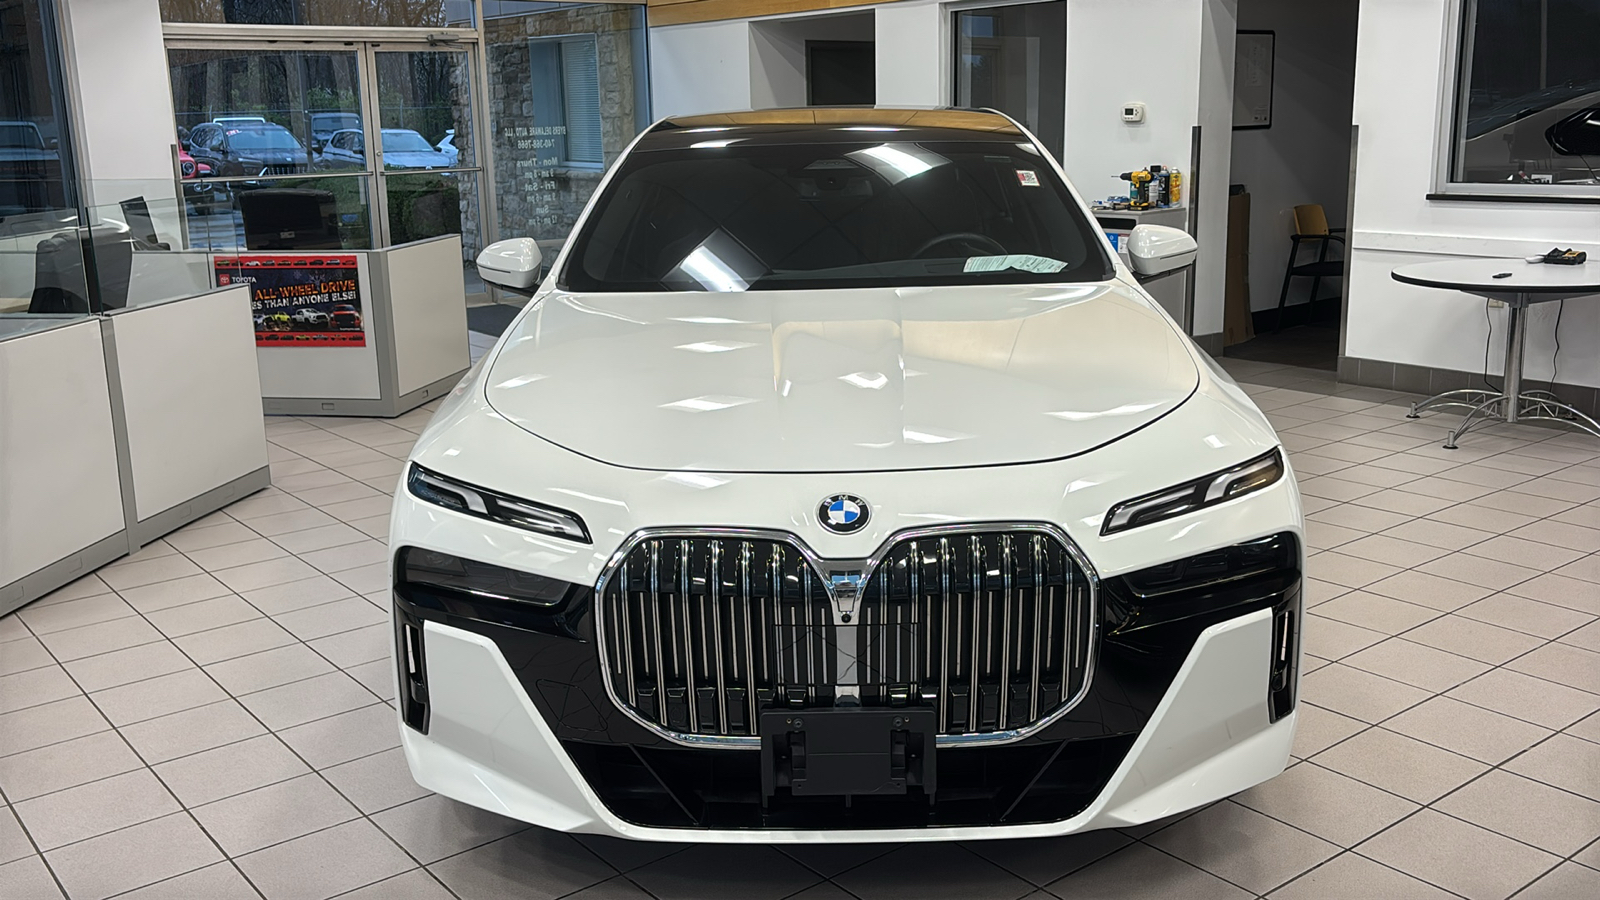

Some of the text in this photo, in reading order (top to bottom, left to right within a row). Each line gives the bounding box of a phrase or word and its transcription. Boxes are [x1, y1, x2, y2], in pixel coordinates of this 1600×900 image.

[231, 276, 257, 284] TOYOTA
[255, 280, 356, 300] ALL-WHEEL DRIVE
[264, 298, 289, 309] THAN
[292, 293, 329, 305] ANYONE
[332, 291, 356, 301] ELSE!
[823, 494, 866, 506] BMW
